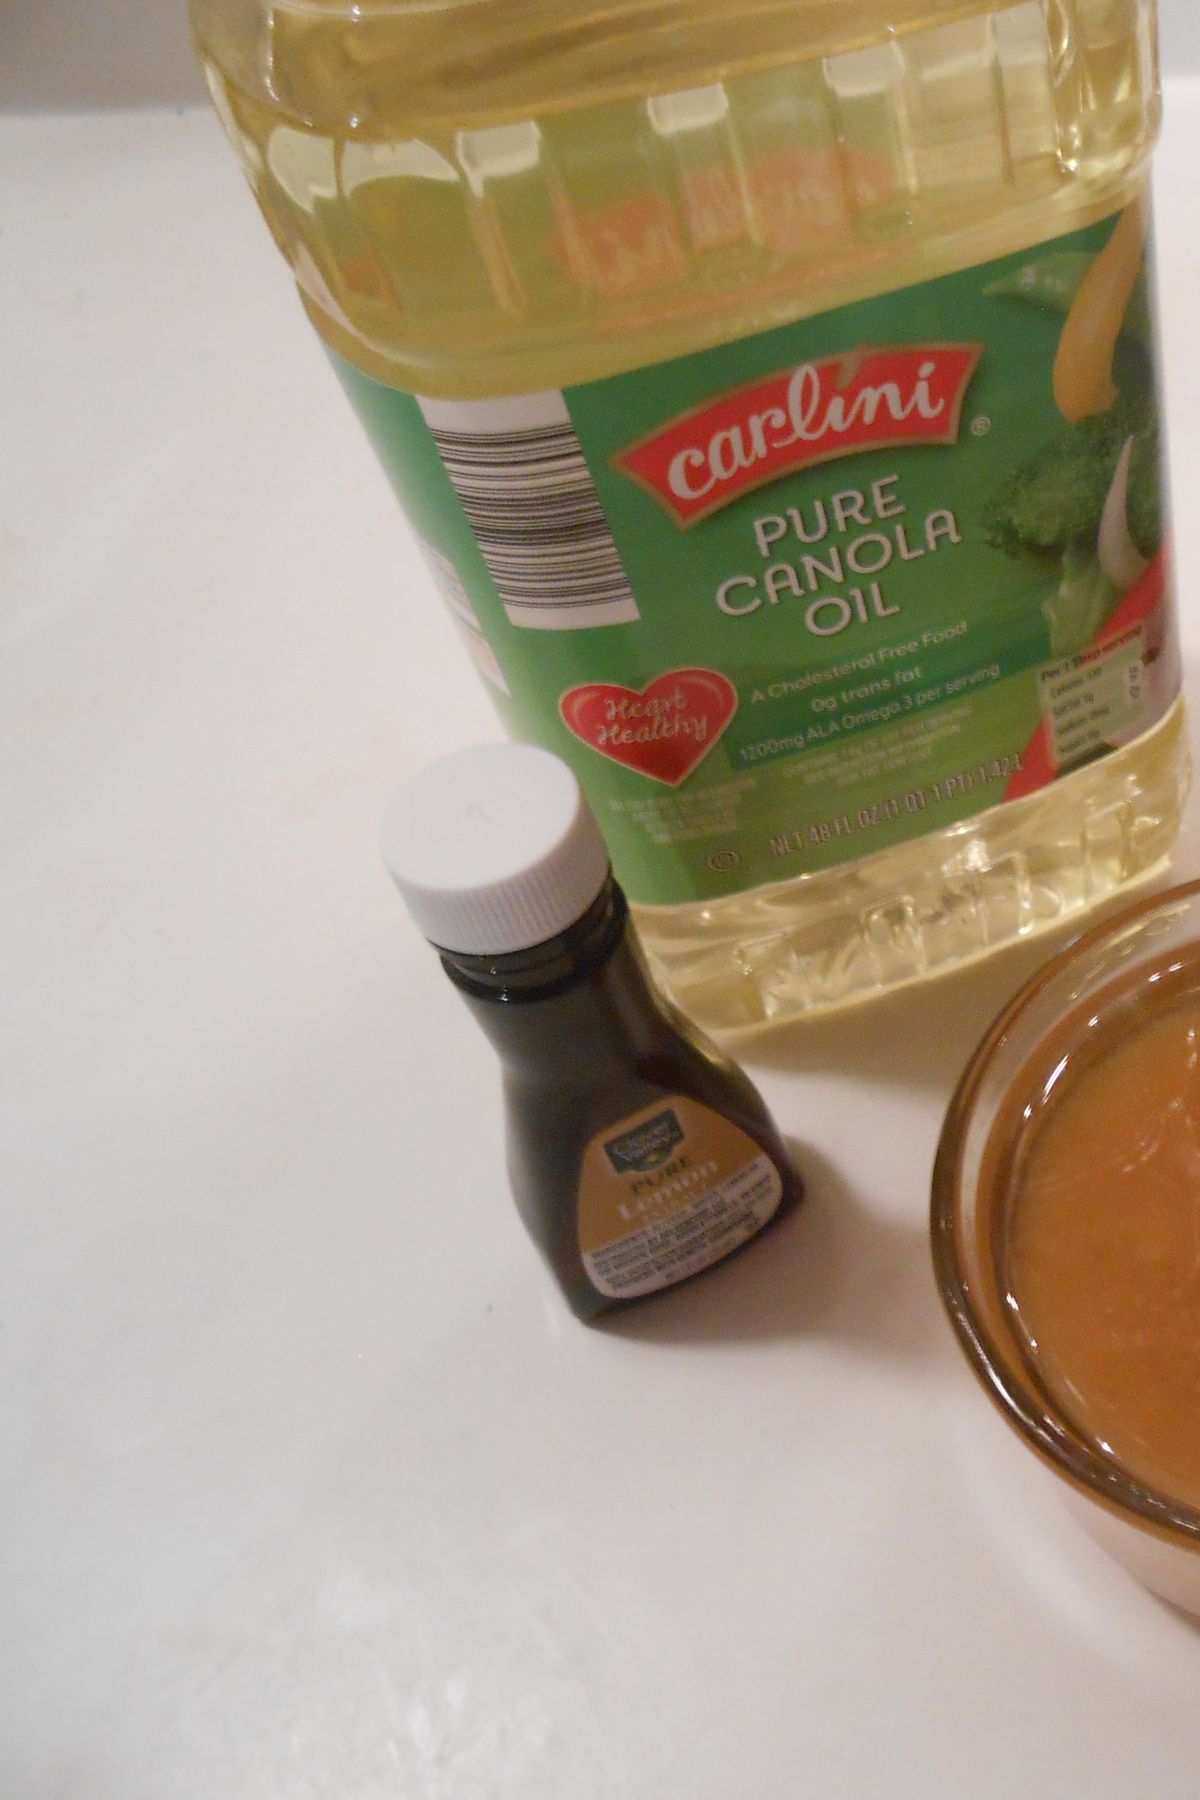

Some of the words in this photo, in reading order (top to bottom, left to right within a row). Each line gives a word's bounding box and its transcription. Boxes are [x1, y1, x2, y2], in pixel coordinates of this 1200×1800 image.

[668, 362, 944, 500] carlini
[754, 475, 906, 557] PURE
[716, 510, 962, 616] CANOLA
[805, 582, 901, 637] OIL
[750, 690, 765, 704] A
[767, 652, 875, 698] Cholesterol
[878, 641, 918, 666] Free
[922, 620, 968, 648] Food
[811, 695, 837, 713] 0g
[841, 678, 892, 703] trans
[895, 667, 922, 684] fat
[597, 716, 707, 745] Healthy
[604, 686, 687, 720] Heart
[740, 735, 804, 761] 1200mg
[807, 718, 839, 740] ALA
[842, 700, 900, 729] Omega
[903, 694, 914, 711] 3
[916, 686, 941, 708] per
[945, 663, 1000, 694] serving
[770, 832, 804, 857] NET
[810, 823, 831, 845] 48
[834, 816, 852, 835] FL
[858, 806, 885, 828] OZ
[933, 783, 941, 801] 1
